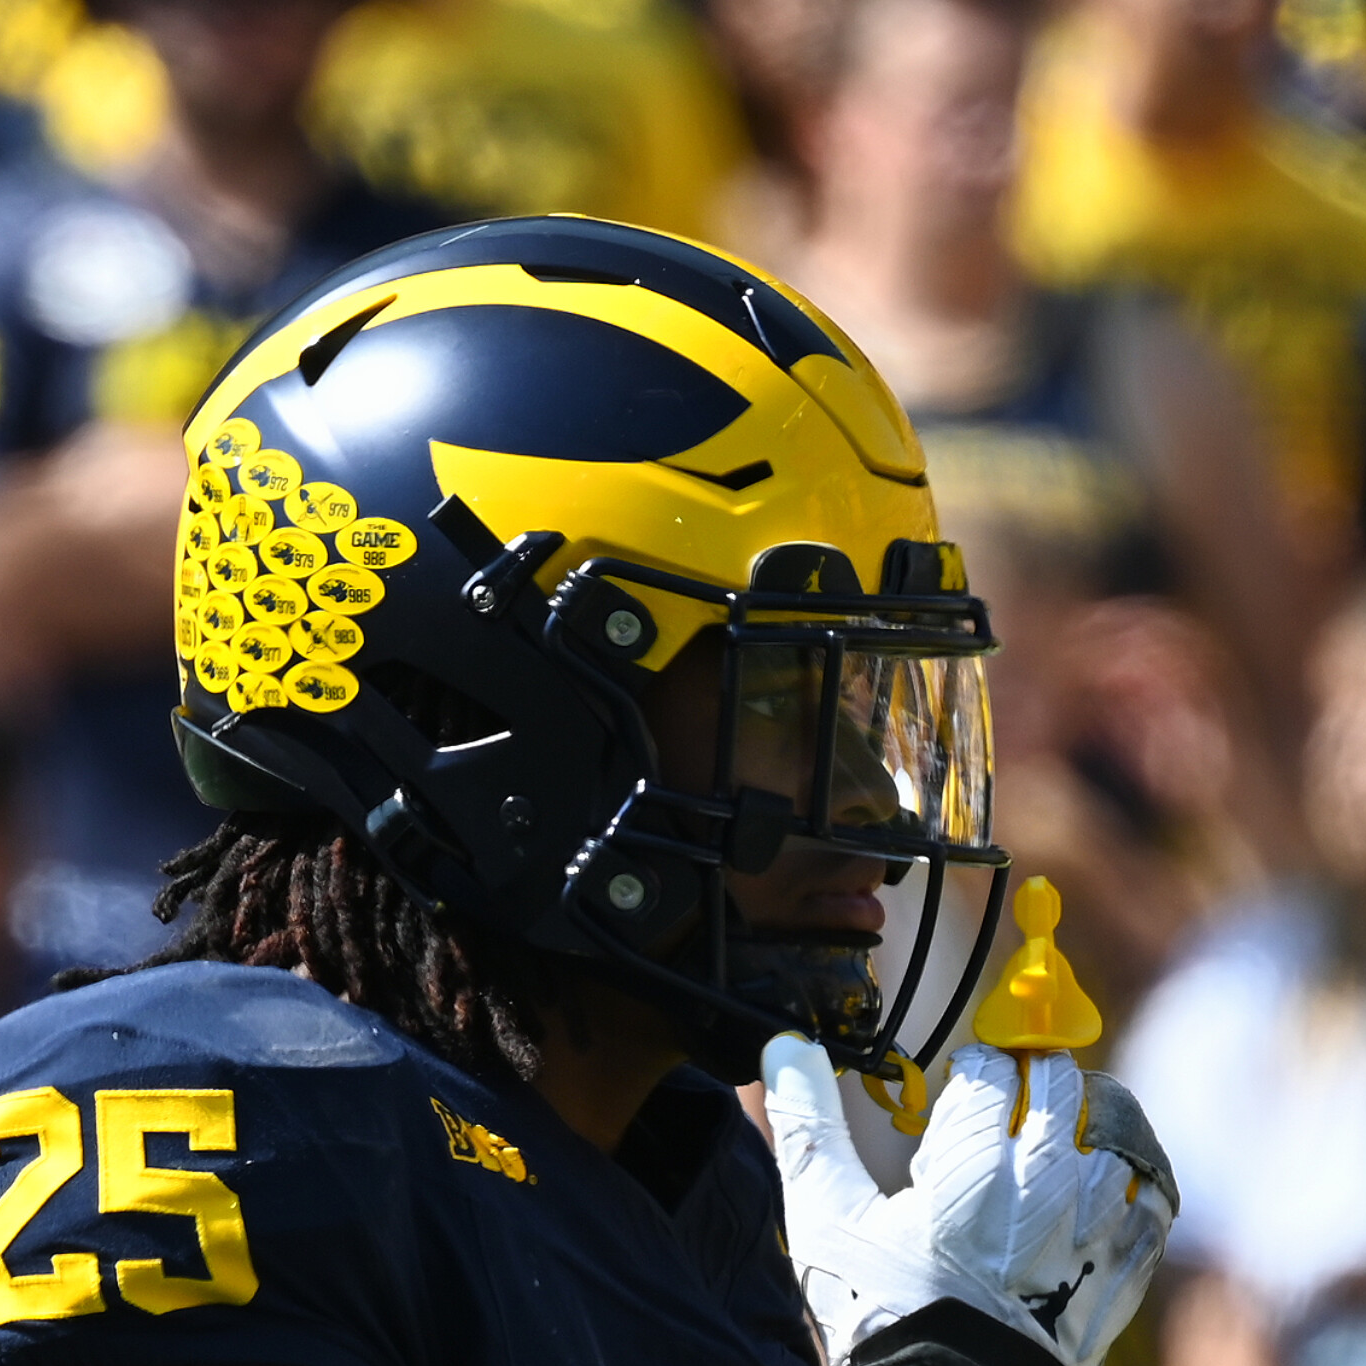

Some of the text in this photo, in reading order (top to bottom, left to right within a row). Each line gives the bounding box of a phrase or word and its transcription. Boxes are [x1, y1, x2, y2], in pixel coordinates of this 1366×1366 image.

[269, 476, 289, 491] 972
[328, 502, 351, 518] 979
[351, 531, 402, 549] GAME
[294, 553, 315, 568] 979
[363, 551, 387, 566] 988
[348, 588, 371, 604] 985
[276, 601, 297, 615] 978
[333, 629, 356, 645] 983
[263, 646, 281, 662] 977
[324, 686, 347, 701] 983
